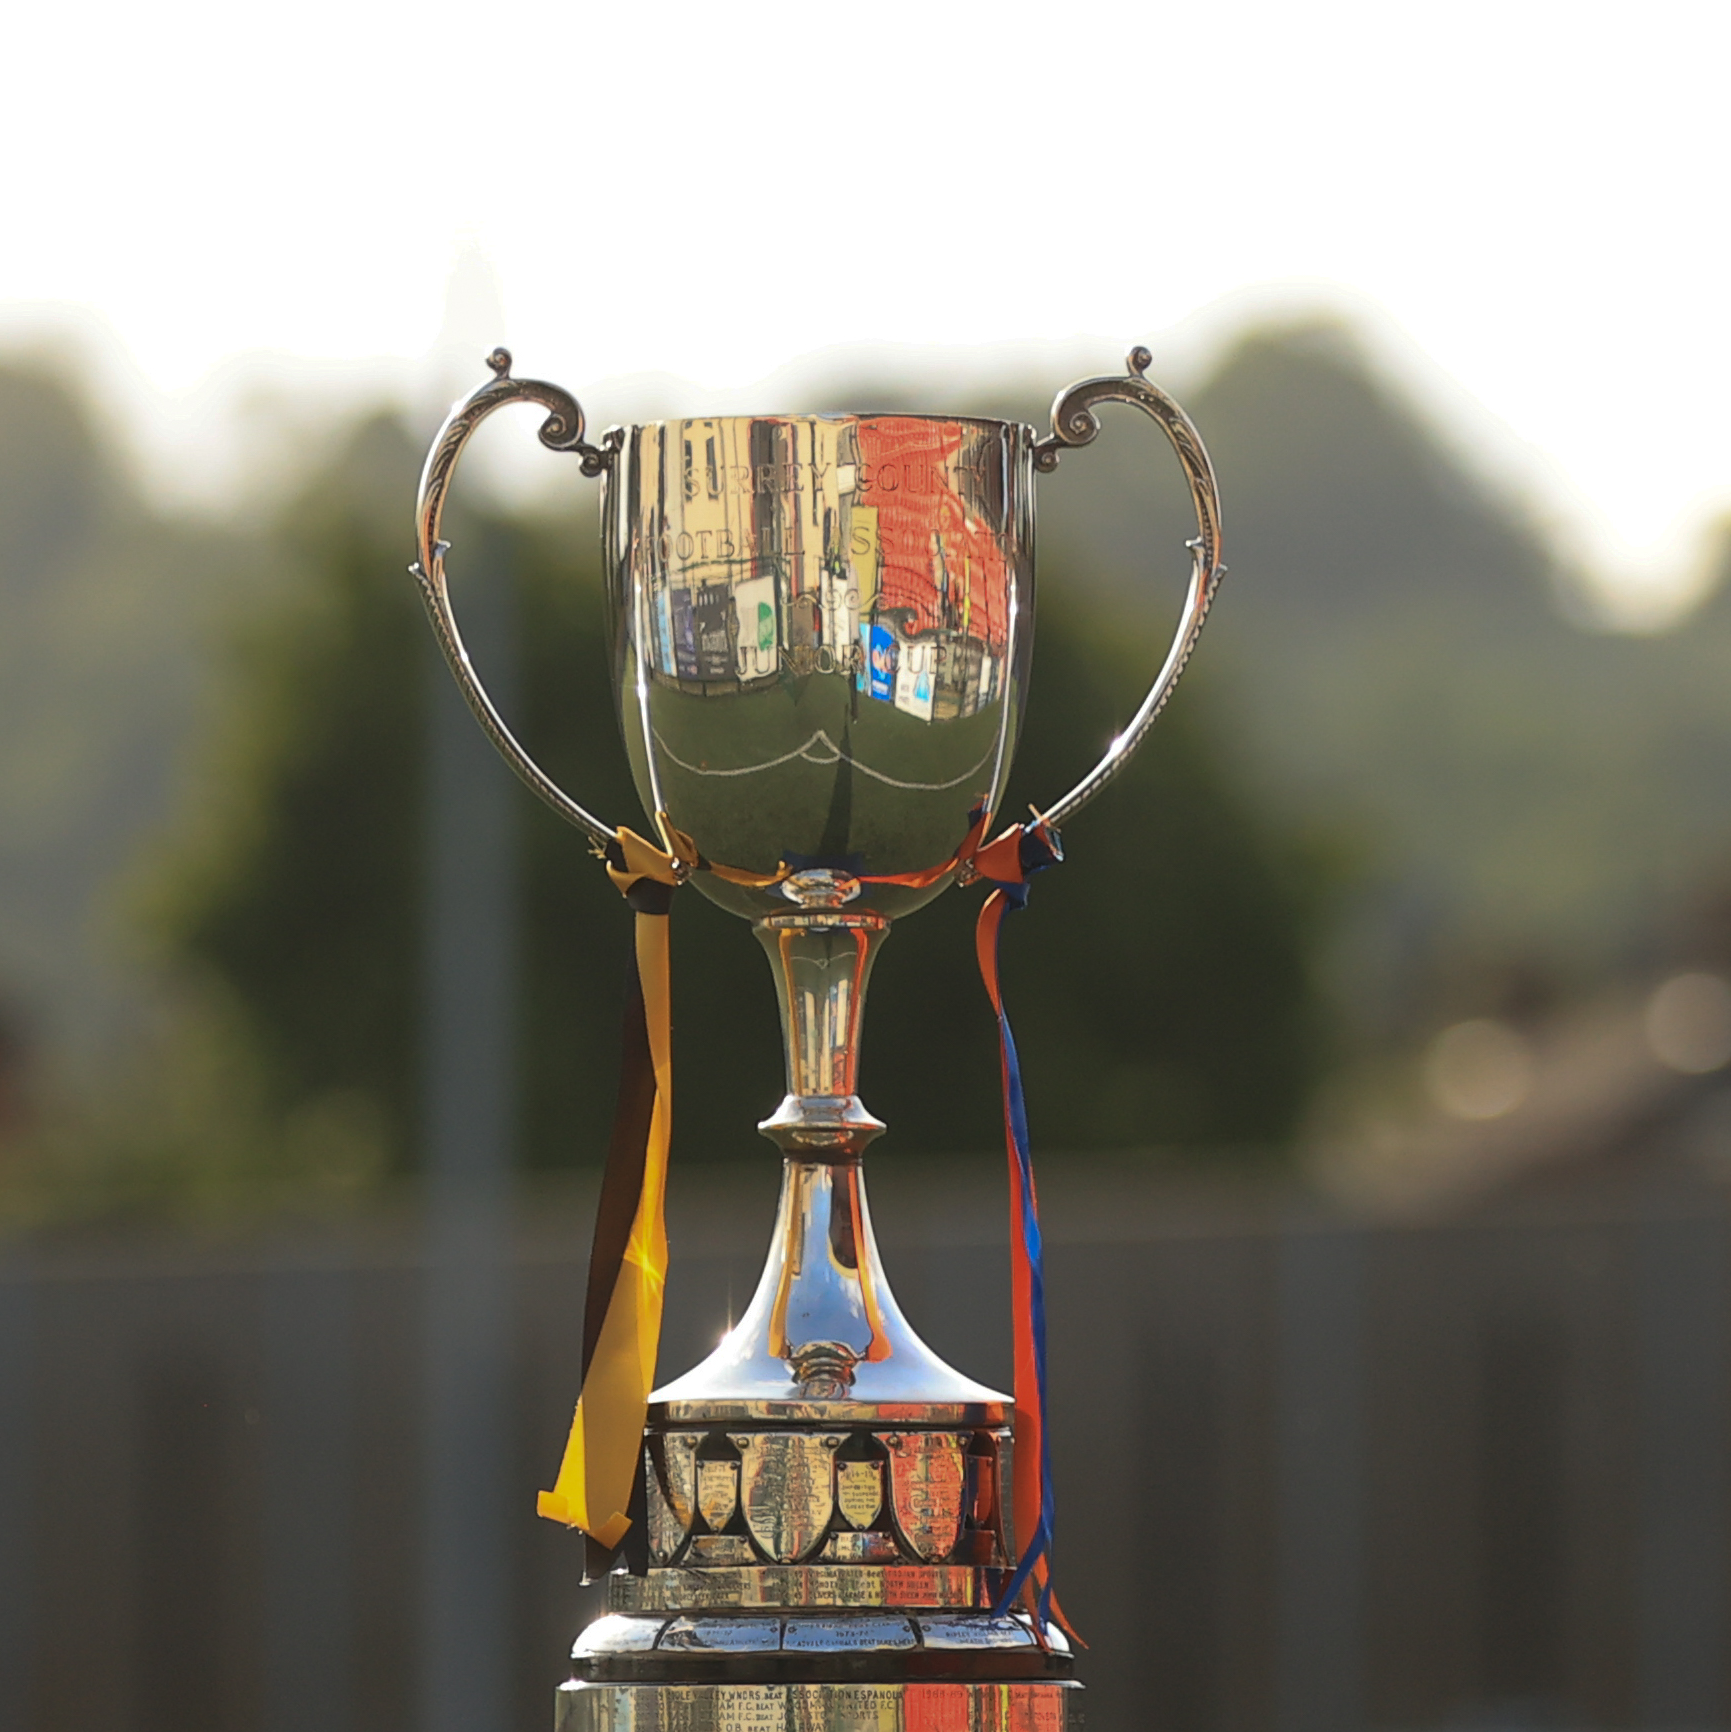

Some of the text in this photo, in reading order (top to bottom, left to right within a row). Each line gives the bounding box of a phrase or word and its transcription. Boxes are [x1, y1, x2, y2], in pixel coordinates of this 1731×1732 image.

[683, 462, 988, 497] SURREY COUNTY
[830, 527, 1020, 562] SSOCTIO
[734, 644, 865, 677] JUNIOR
[884, 642, 948, 675] CUP
[763, 1691, 784, 1700] BEAT
[787, 1690, 851, 1700] SSOCITION
[756, 1702, 775, 1711] BEAT
[756, 1713, 774, 1721] BEAT
[747, 1725, 771, 1732] BEAT
[776, 1722, 827, 1732] HAWAY
